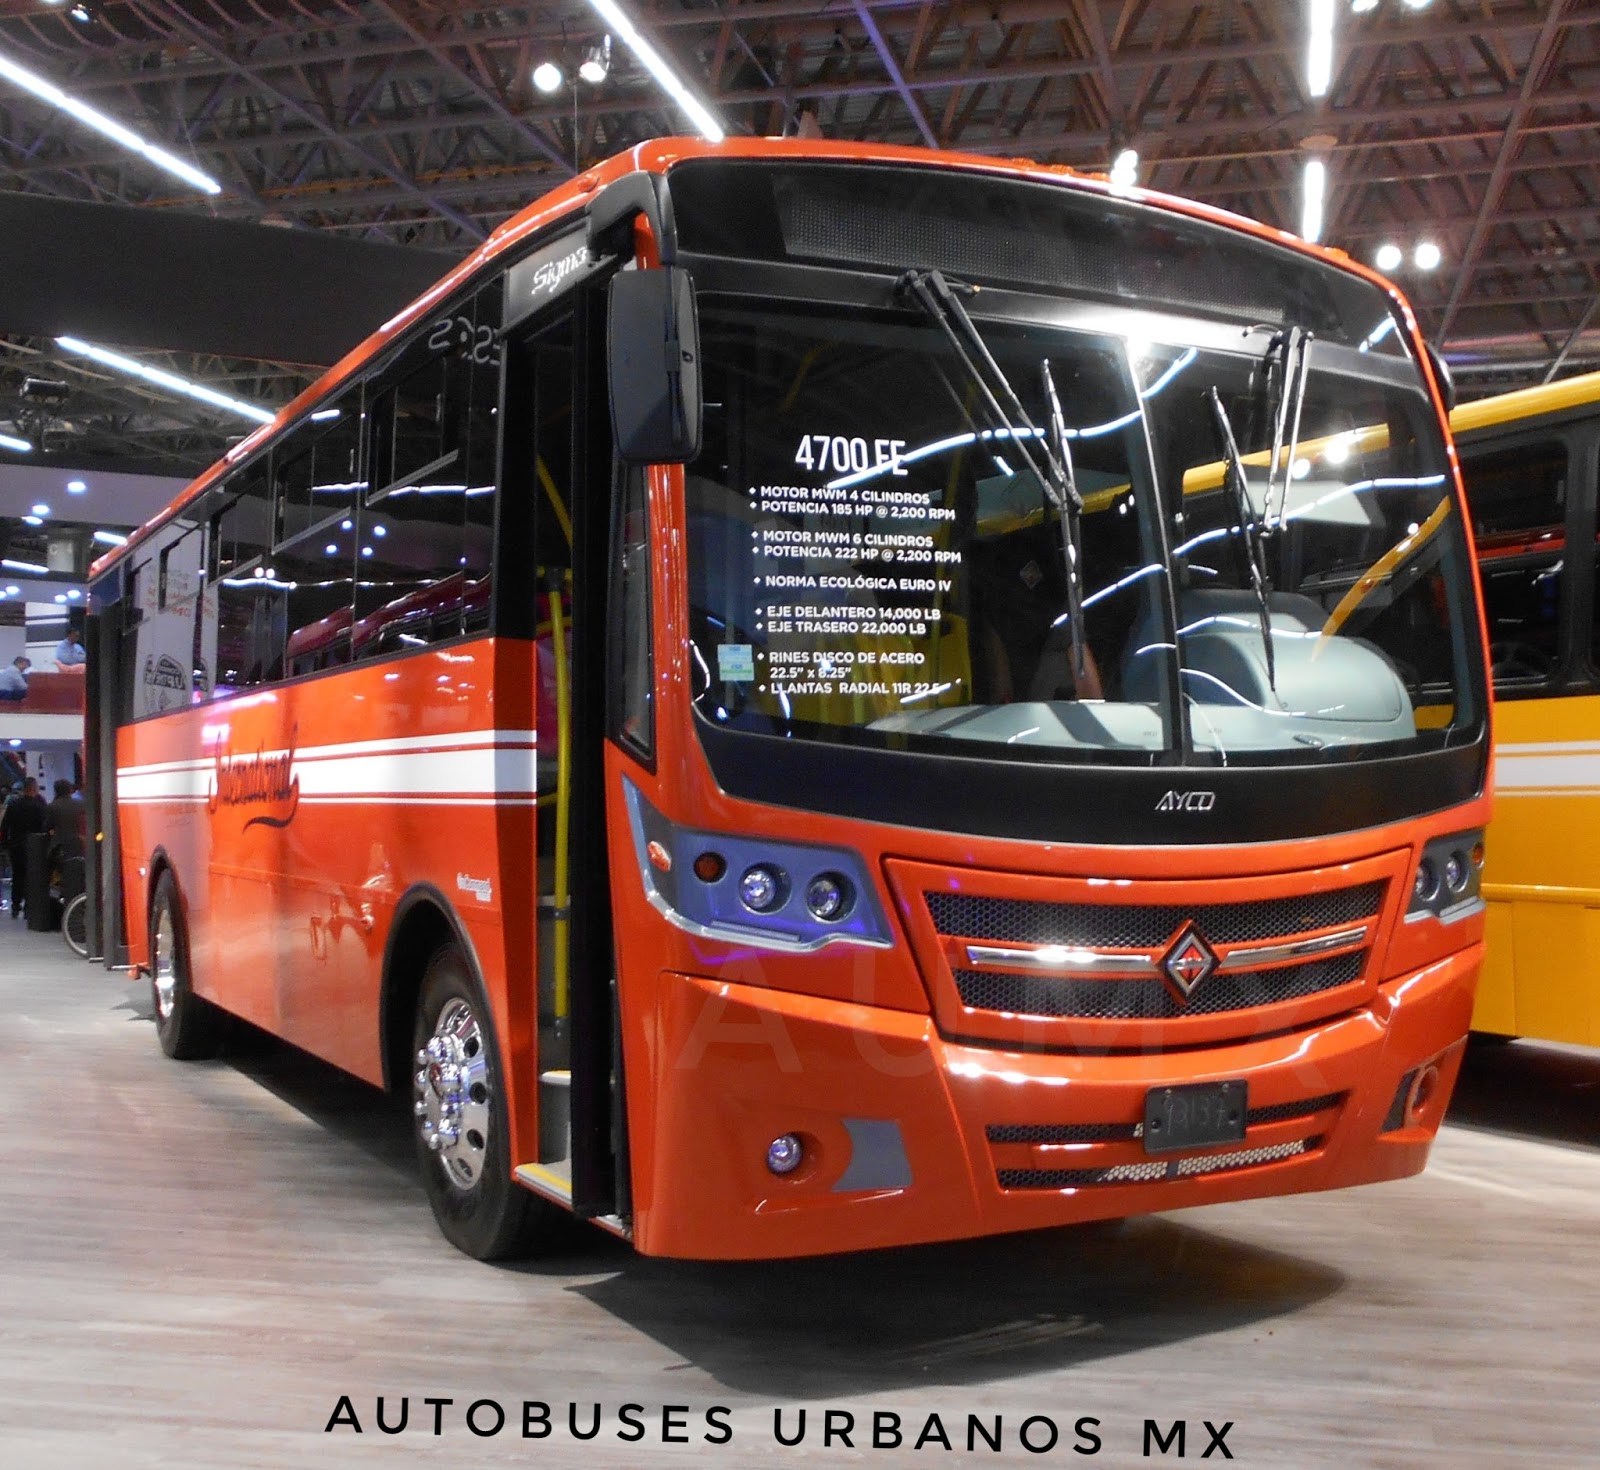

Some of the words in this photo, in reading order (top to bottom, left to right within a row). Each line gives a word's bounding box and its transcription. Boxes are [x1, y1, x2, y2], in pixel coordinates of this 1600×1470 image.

[531, 246, 588, 295] Sigma
[795, 434, 869, 473] 4700
[874, 438, 909, 476] FE
[760, 486, 809, 499] MOTOR
[811, 488, 847, 501] MWM
[849, 490, 859, 501] 4
[861, 490, 930, 505] CILINDROS
[761, 500, 829, 514] POTENCIA
[831, 503, 853, 515] 185
[855, 504, 873, 516] HP
[875, 505, 889, 519] @
[890, 506, 926, 519] 2,200
[928, 508, 956, 521] RPM
[763, 530, 812, 543] MOTOR
[814, 531, 850, 544] MWM
[852, 532, 862, 544] 6
[864, 533, 934, 548] CILINDROS
[763, 545, 832, 558] POTENCIA
[834, 547, 858, 559] 222
[860, 548, 879, 560] HP
[881, 548, 894, 562] @
[896, 549, 932, 562] 2,200
[934, 551, 962, 563] RPM
[765, 575, 817, 588] NORMA
[819, 574, 897, 590] ECOLÓGICA
[899, 578, 936, 591] EURO
[938, 580, 952, 592] IV
[766, 605, 792, 618] EJE
[794, 606, 876, 619] DELANTERO
[878, 607, 921, 620] 14,000
[924, 608, 942, 620] LB
[767, 620, 792, 633] EJE
[795, 621, 859, 633] TRASERO
[861, 622, 907, 636] 22,000
[909, 623, 927, 635] LB
[769, 651, 810, 664] RINES
[812, 651, 855, 664] DISCO
[857, 652, 876, 664] DE
[879, 652, 925, 664] ACERO
[770, 682, 833, 694] LLANTAS
[839, 682, 890, 694] RADIAL
[892, 682, 912, 694] 11R
[1154, 790, 1216, 810] AYCO
